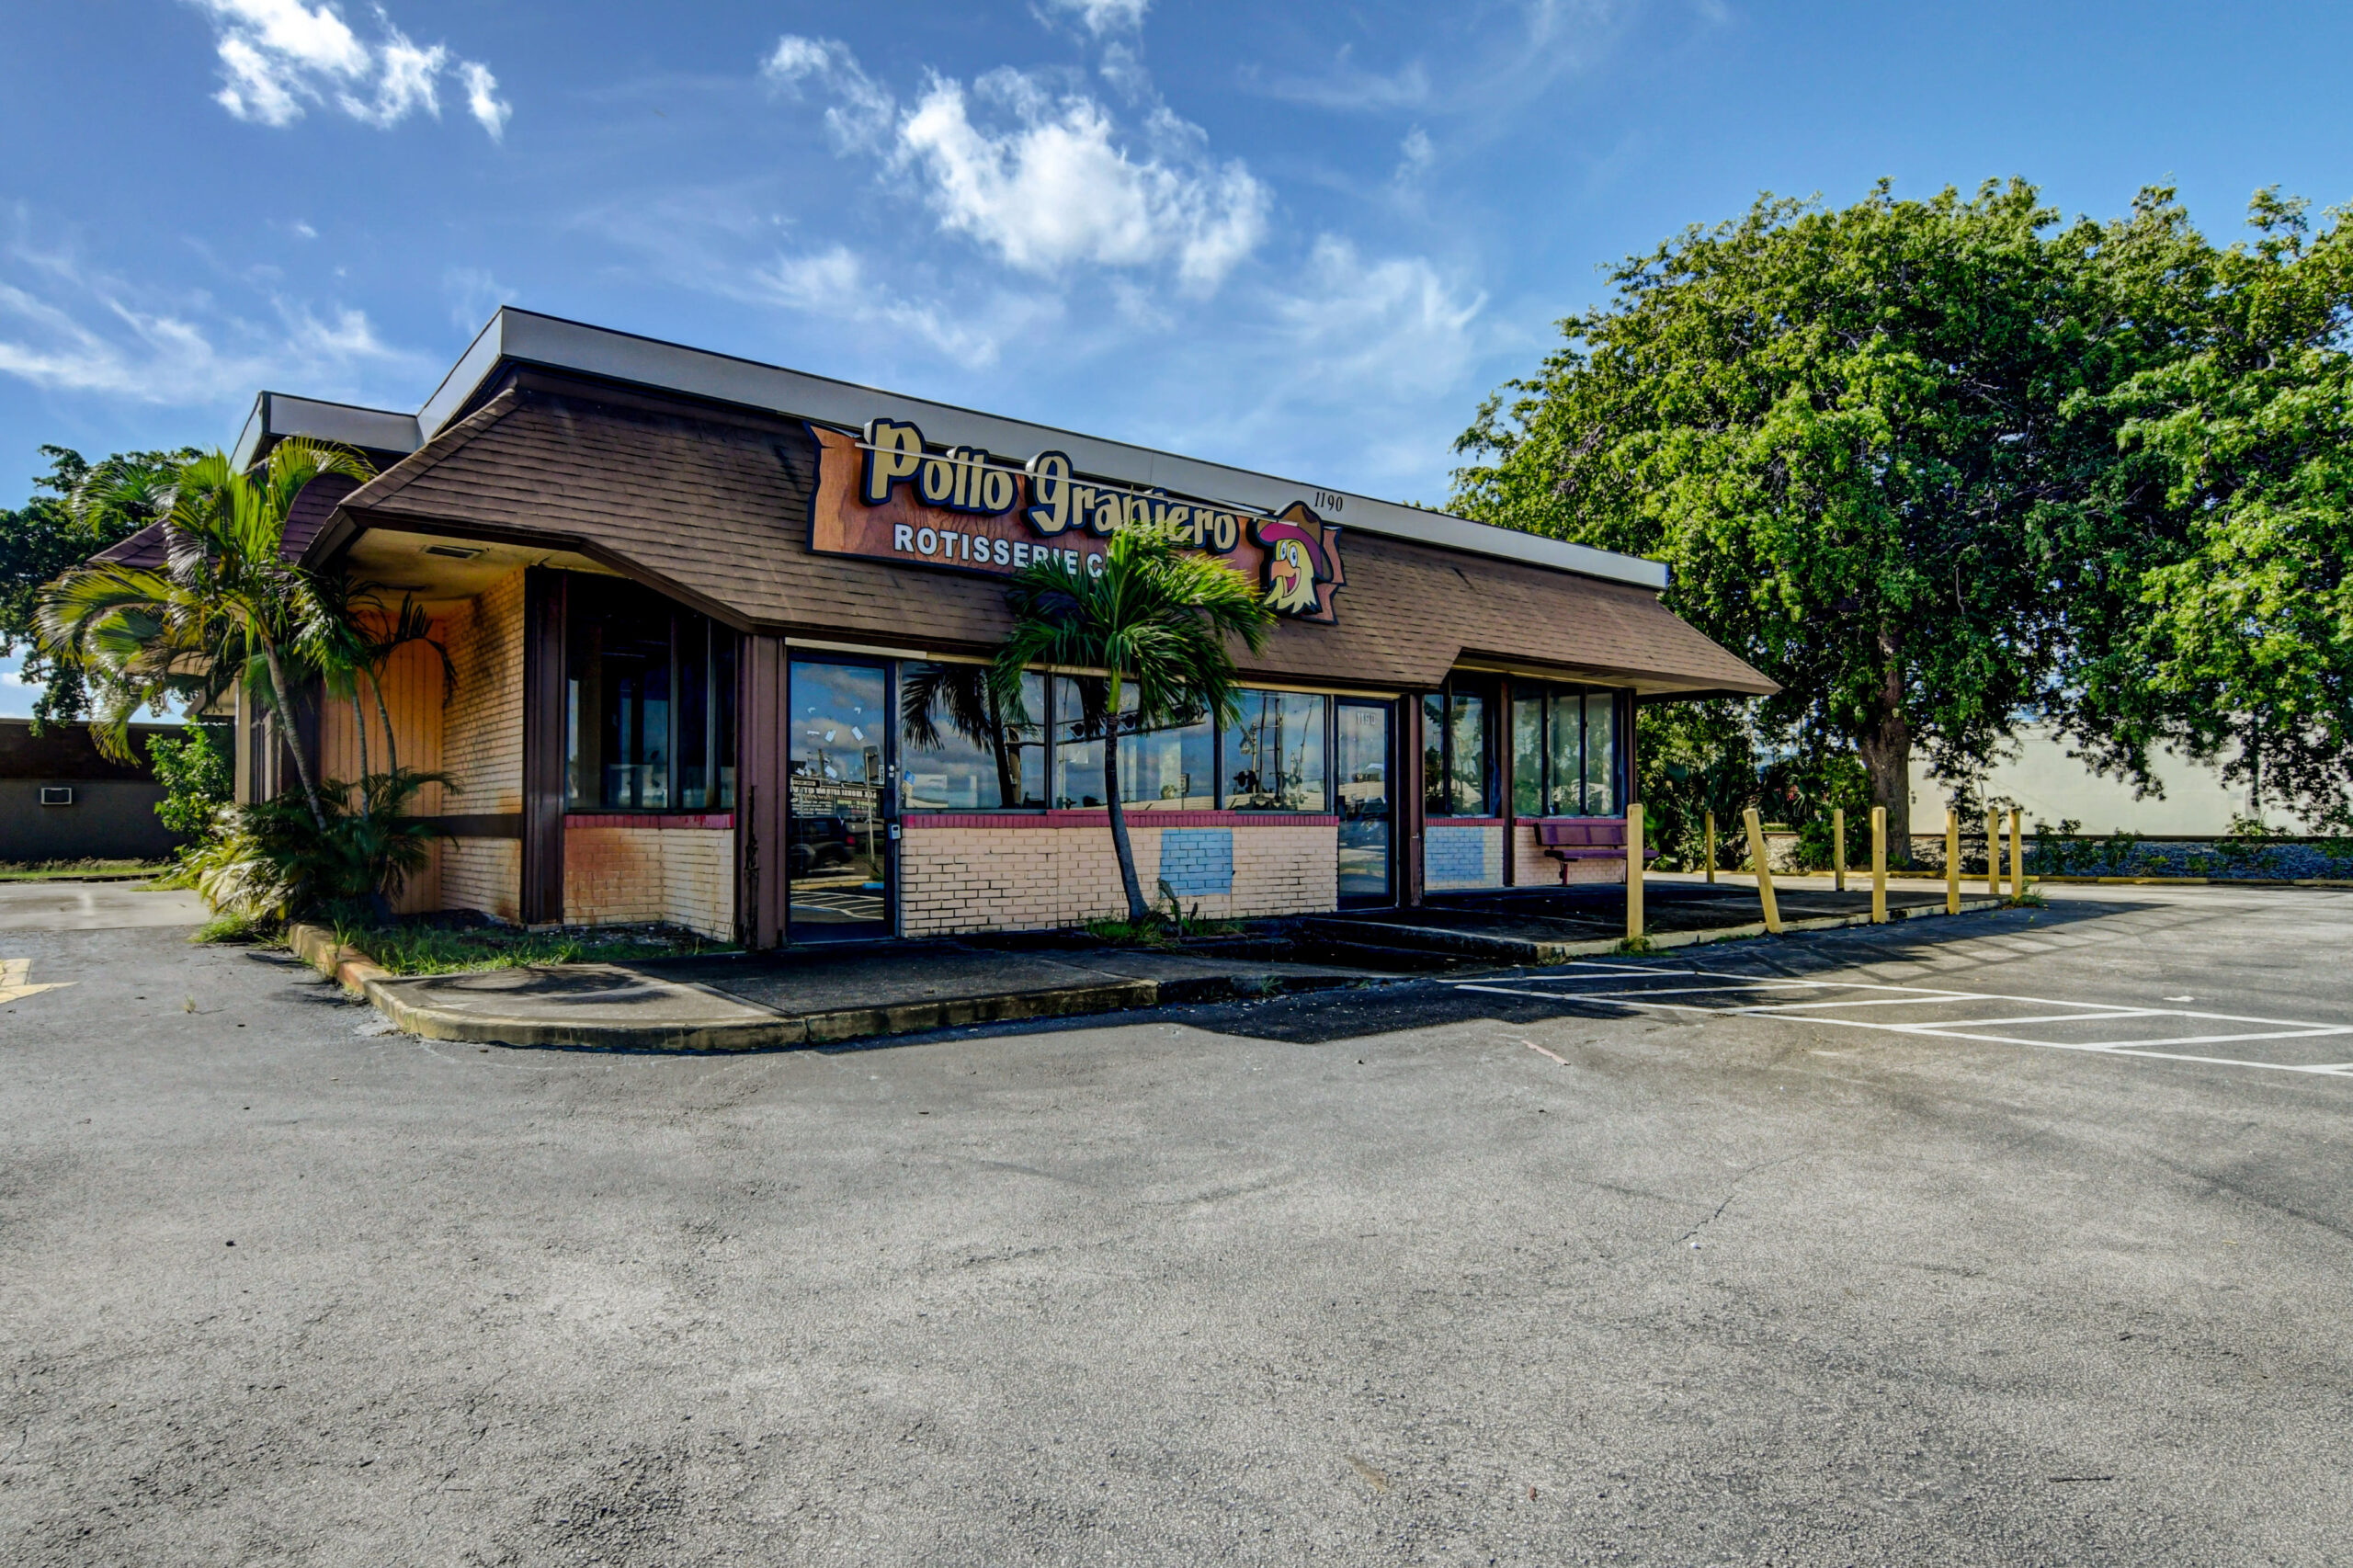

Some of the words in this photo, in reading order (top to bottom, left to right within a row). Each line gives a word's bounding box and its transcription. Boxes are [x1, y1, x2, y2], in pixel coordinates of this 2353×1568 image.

[867, 420, 1016, 514] Pollo
[1314, 492, 1343, 512] 1190
[893, 523, 1087, 575] ROTISSERIE
